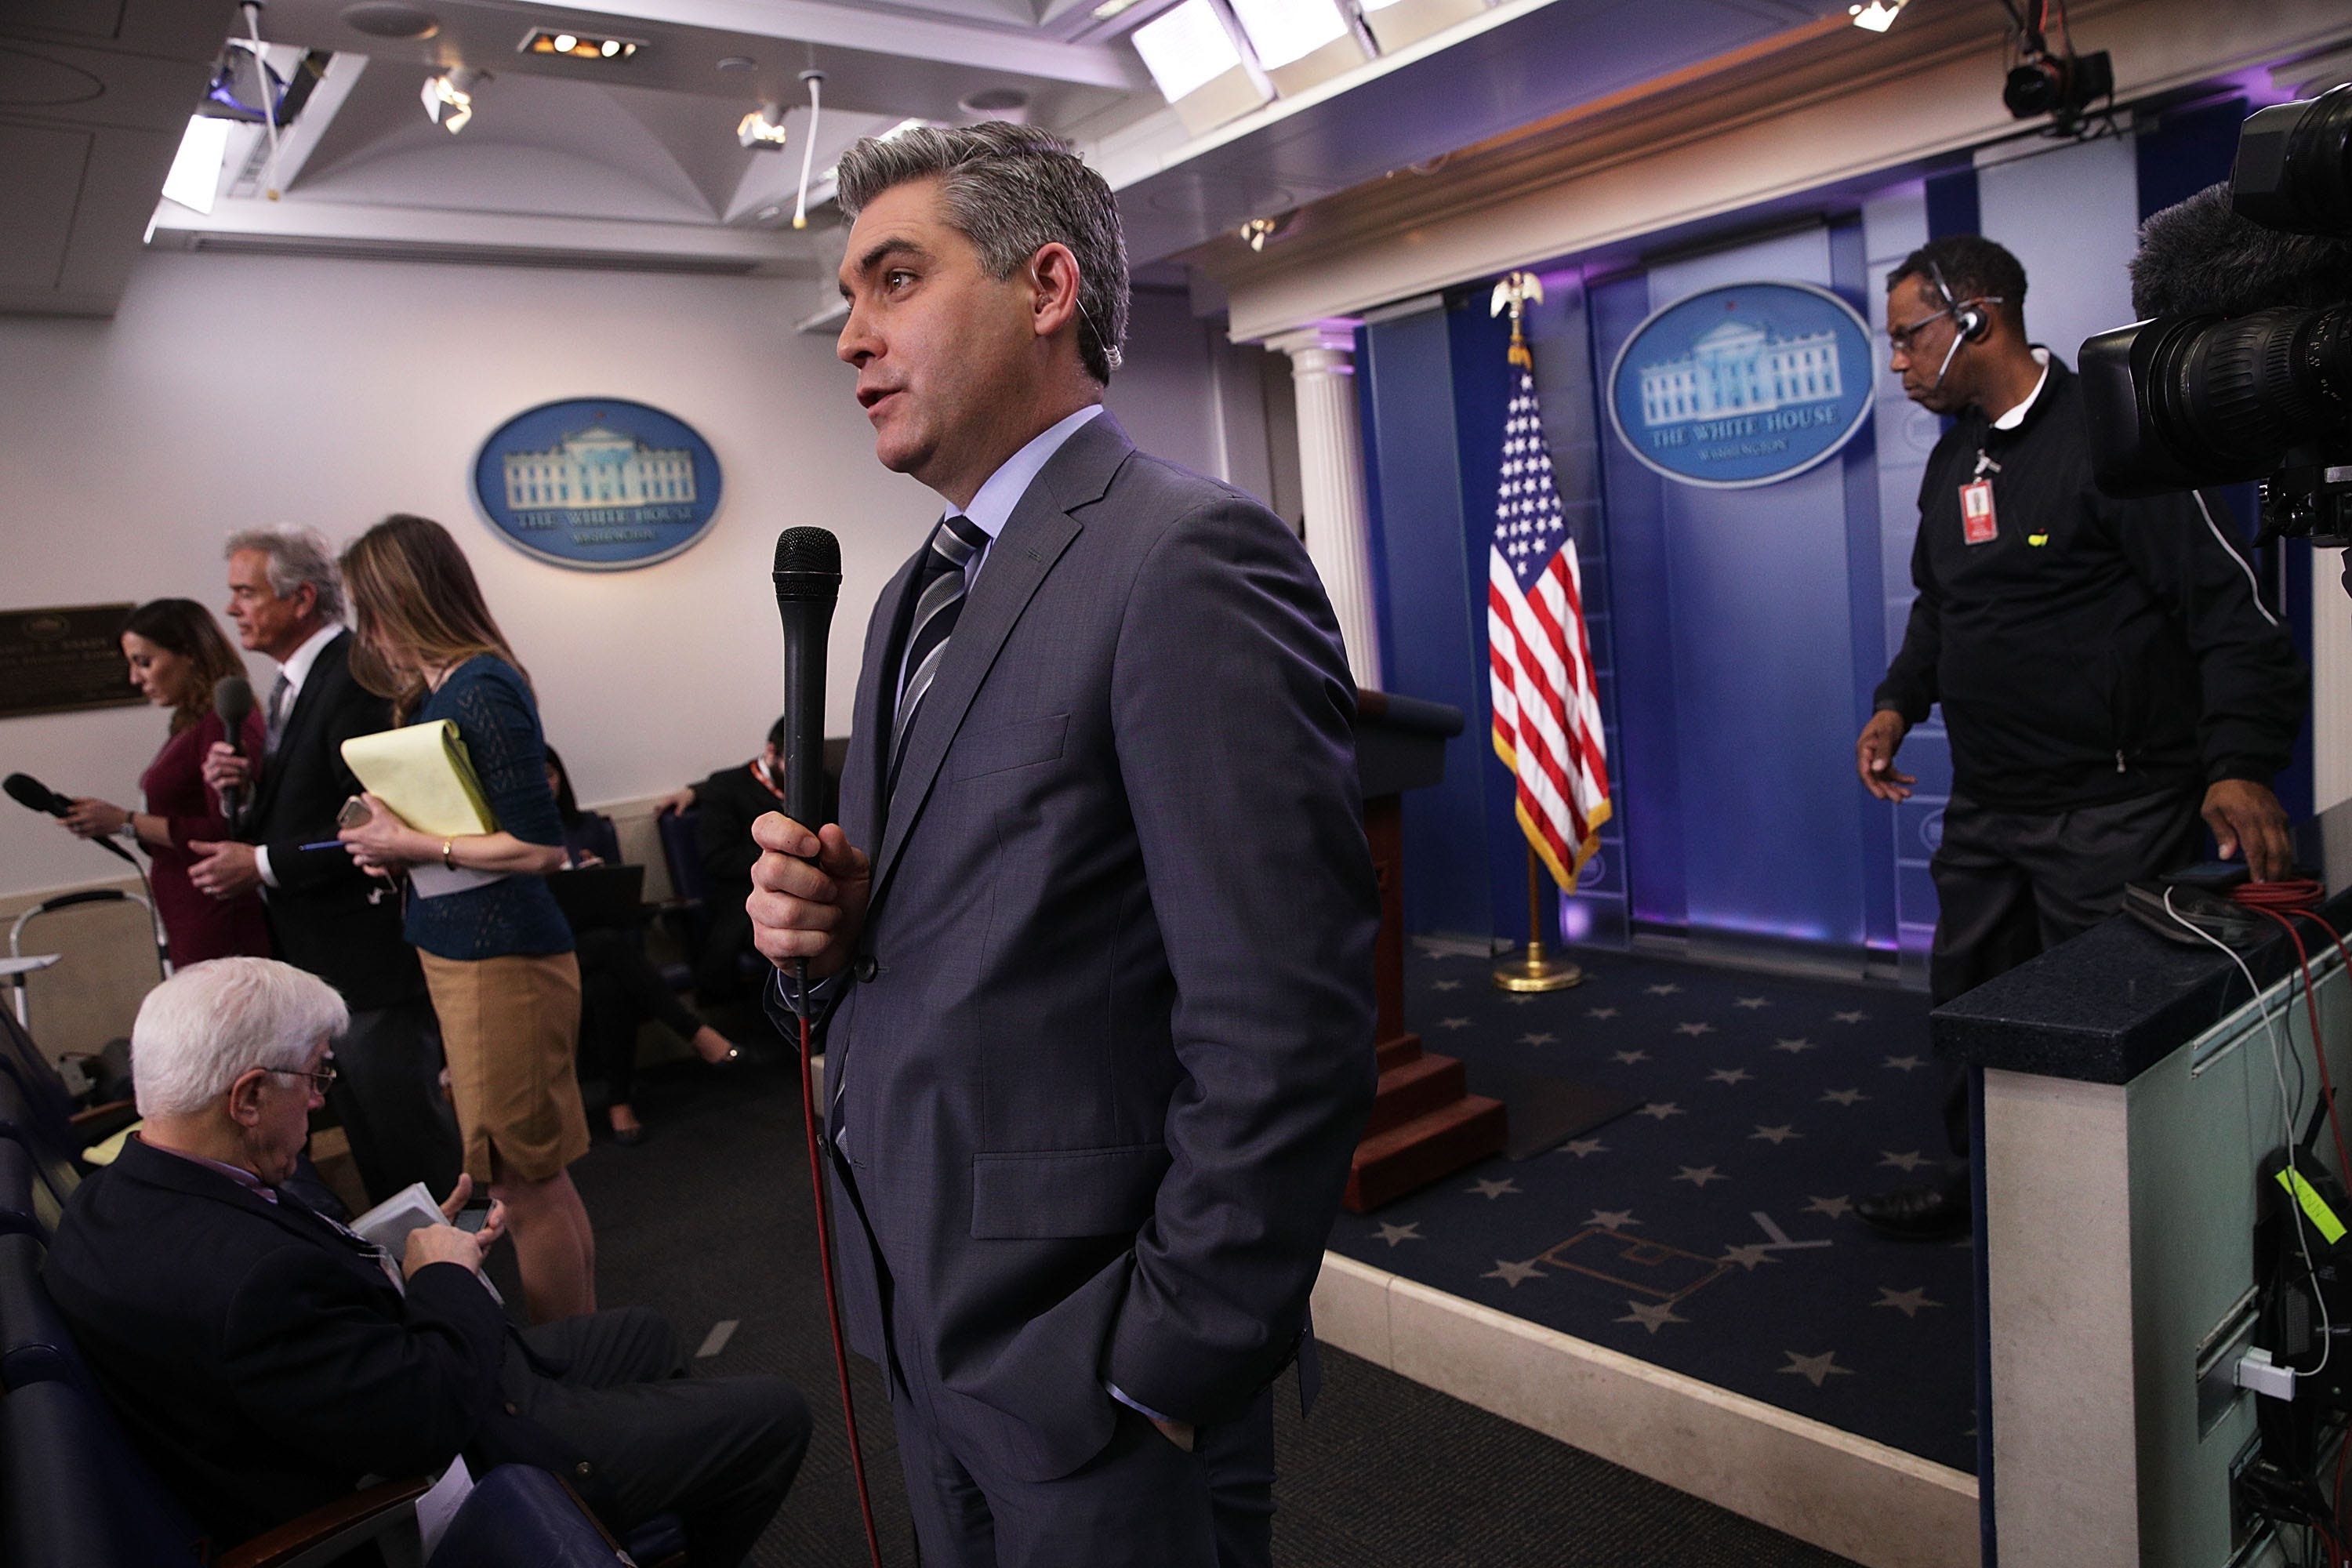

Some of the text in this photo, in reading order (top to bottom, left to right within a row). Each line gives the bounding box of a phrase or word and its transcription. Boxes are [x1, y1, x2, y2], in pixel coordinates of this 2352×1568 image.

[1653, 405, 1838, 448] THE WHITE HOUSE
[517, 507, 693, 528] THE WHITE HOUSE
